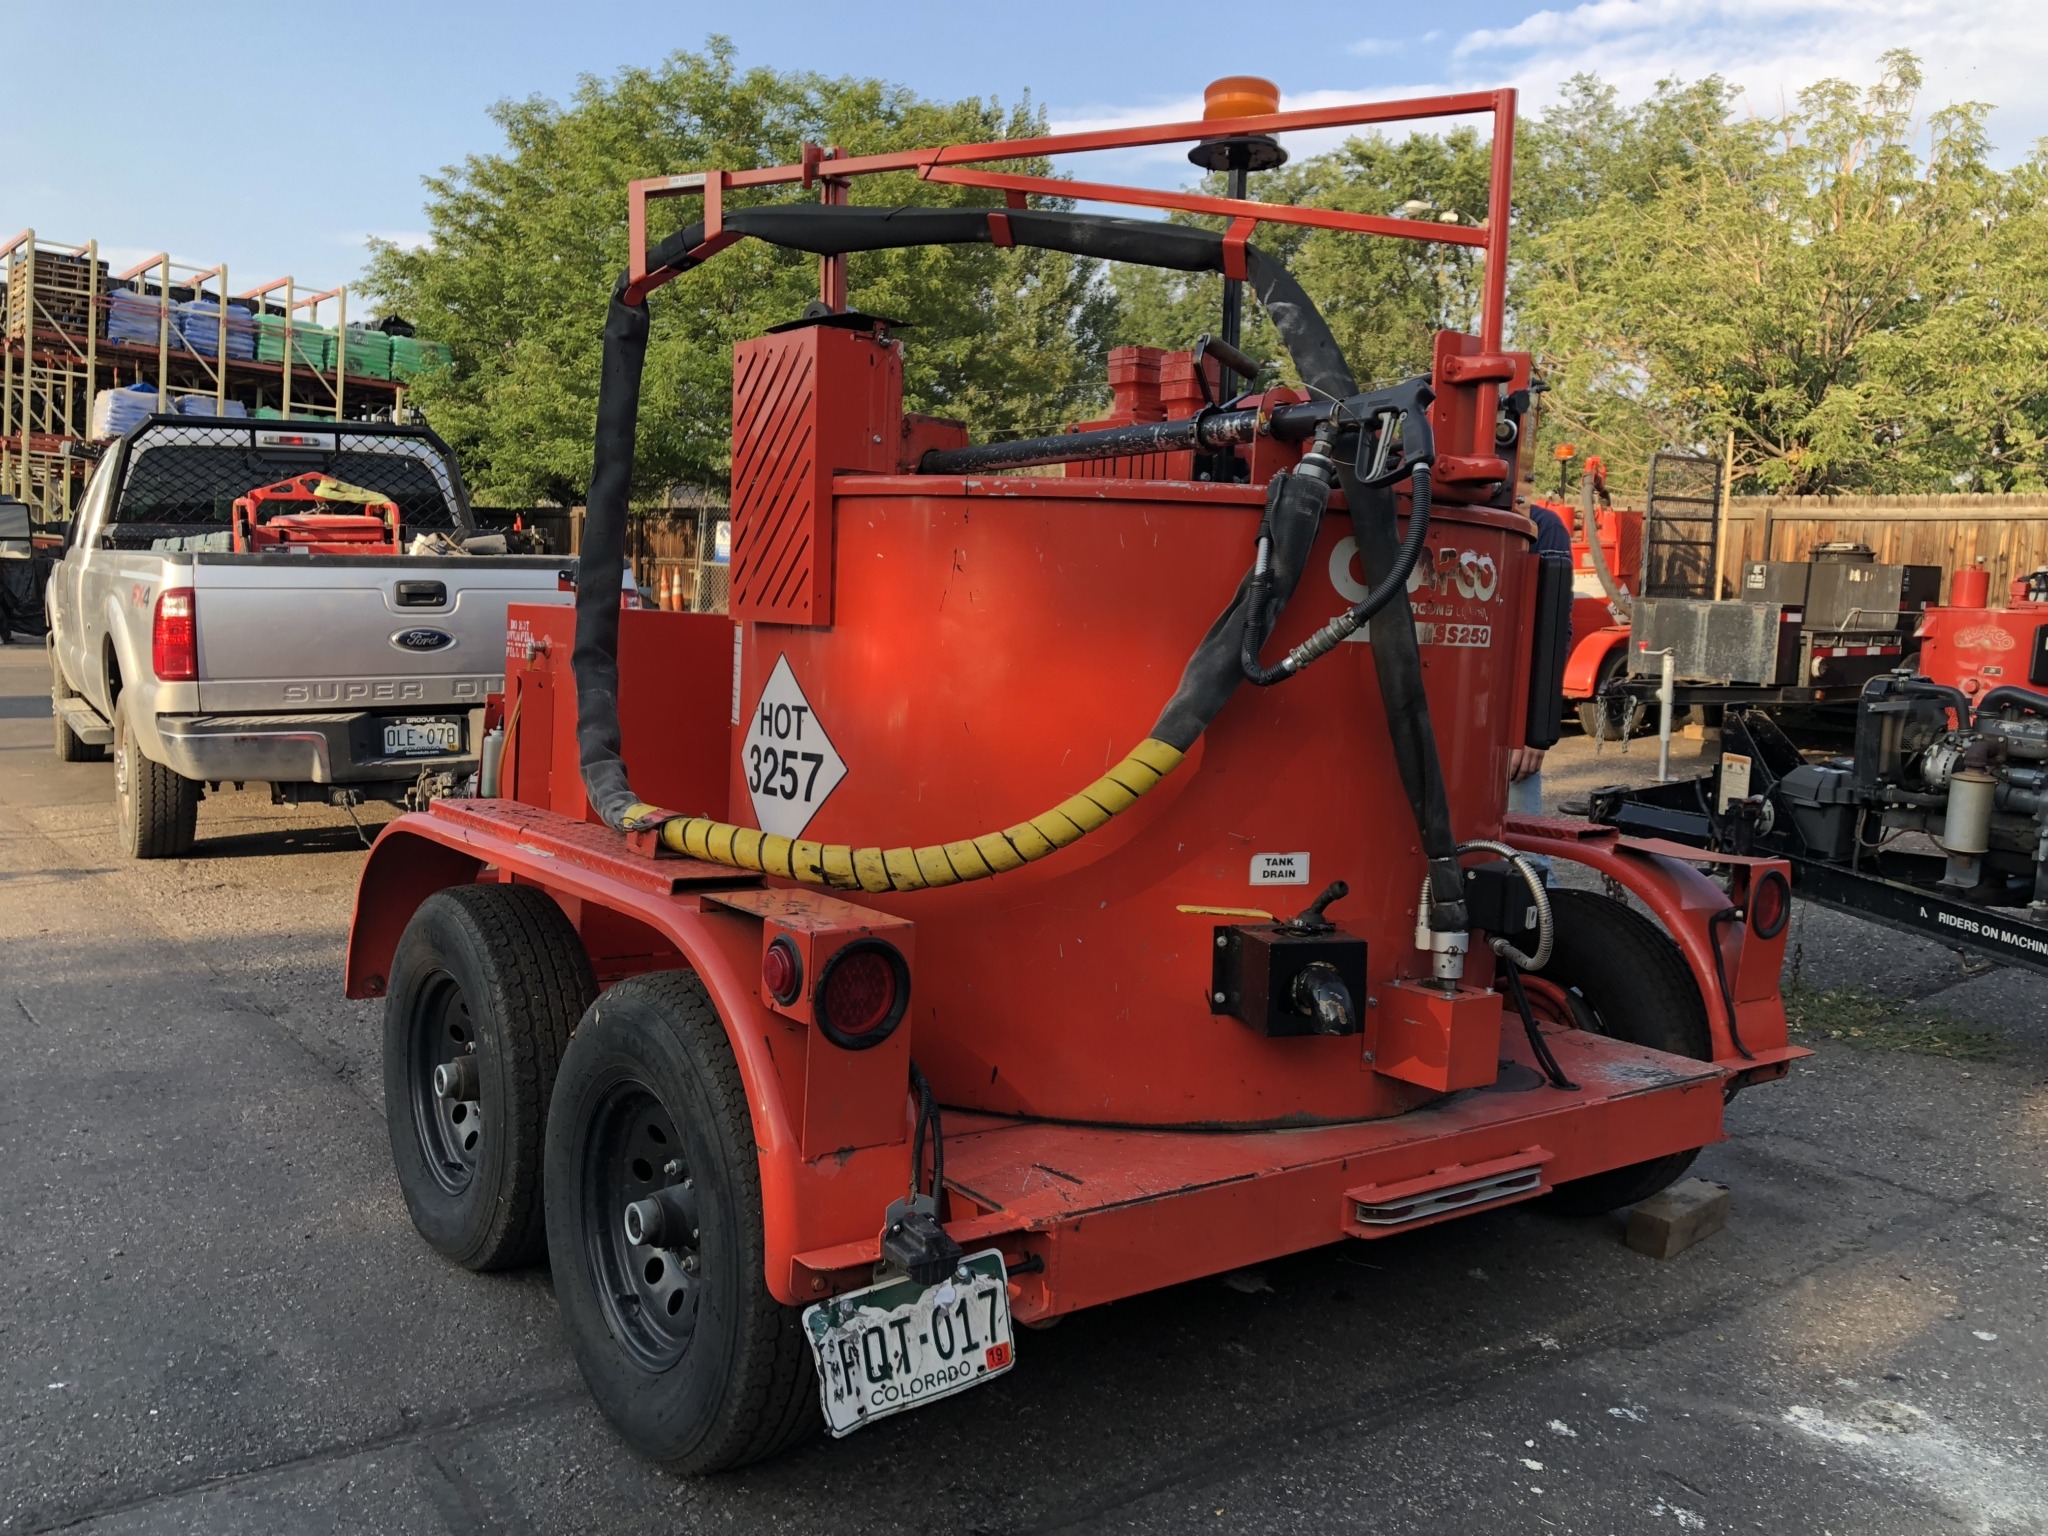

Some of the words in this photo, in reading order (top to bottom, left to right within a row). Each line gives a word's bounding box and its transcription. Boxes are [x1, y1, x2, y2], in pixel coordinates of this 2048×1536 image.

[406, 631, 439, 646] Ford
[283, 681, 424, 703] SUPER
[452, 679, 505, 700] DU
[406, 716, 436, 724] GROOVE
[760, 702, 808, 741] HOT
[749, 744, 824, 802] 3257
[1262, 869, 1296, 879] DRAIN
[1265, 857, 1294, 867] TANK
[1938, 911, 1980, 934] RIDERS
[1981, 925, 1999, 940] ON
[2001, 930, 2048, 956] MACHIN
[870, 1360, 971, 1406] COLORADO
